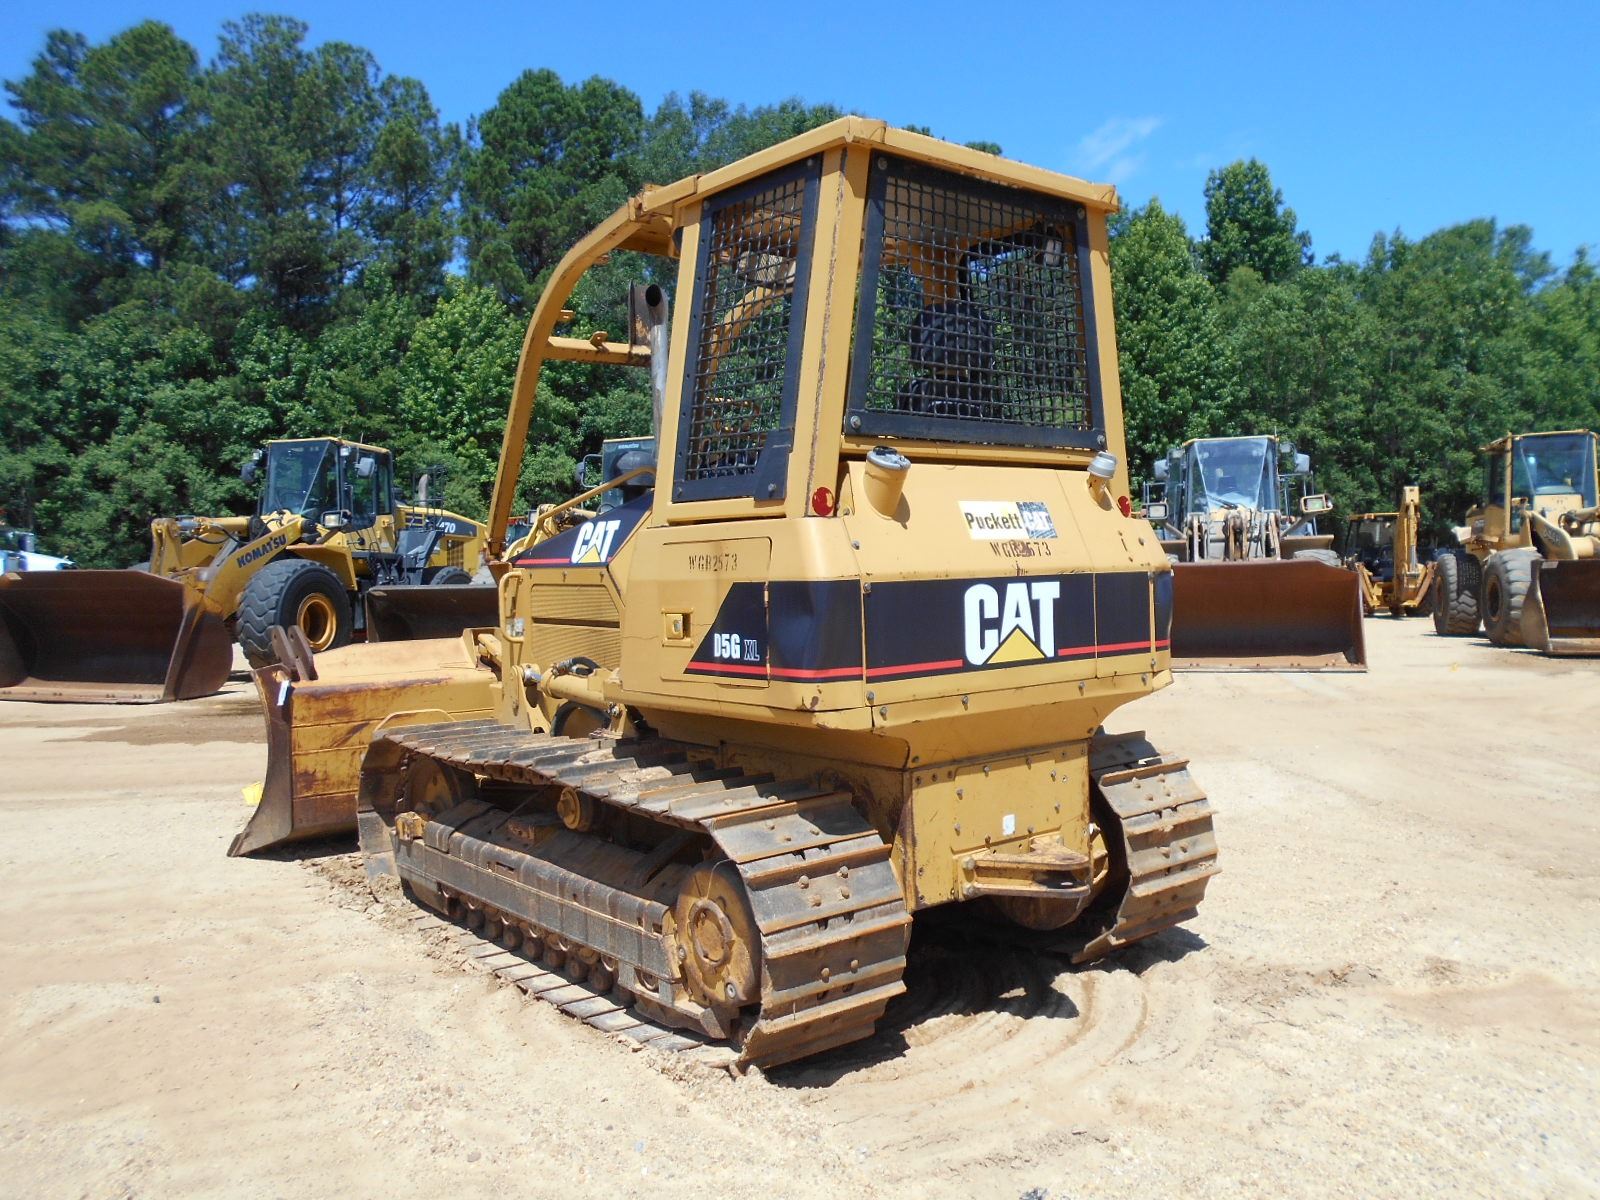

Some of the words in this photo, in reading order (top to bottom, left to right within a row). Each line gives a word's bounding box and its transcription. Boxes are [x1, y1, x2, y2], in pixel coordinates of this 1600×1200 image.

[964, 512, 1022, 529] Puckett
[1023, 509, 1052, 531] CAT
[237, 534, 287, 568] KOMATSU
[571, 520, 621, 563] CAT
[964, 581, 1060, 666] CAT
[714, 633, 741, 659] D5G
[743, 639, 760, 661] XL
